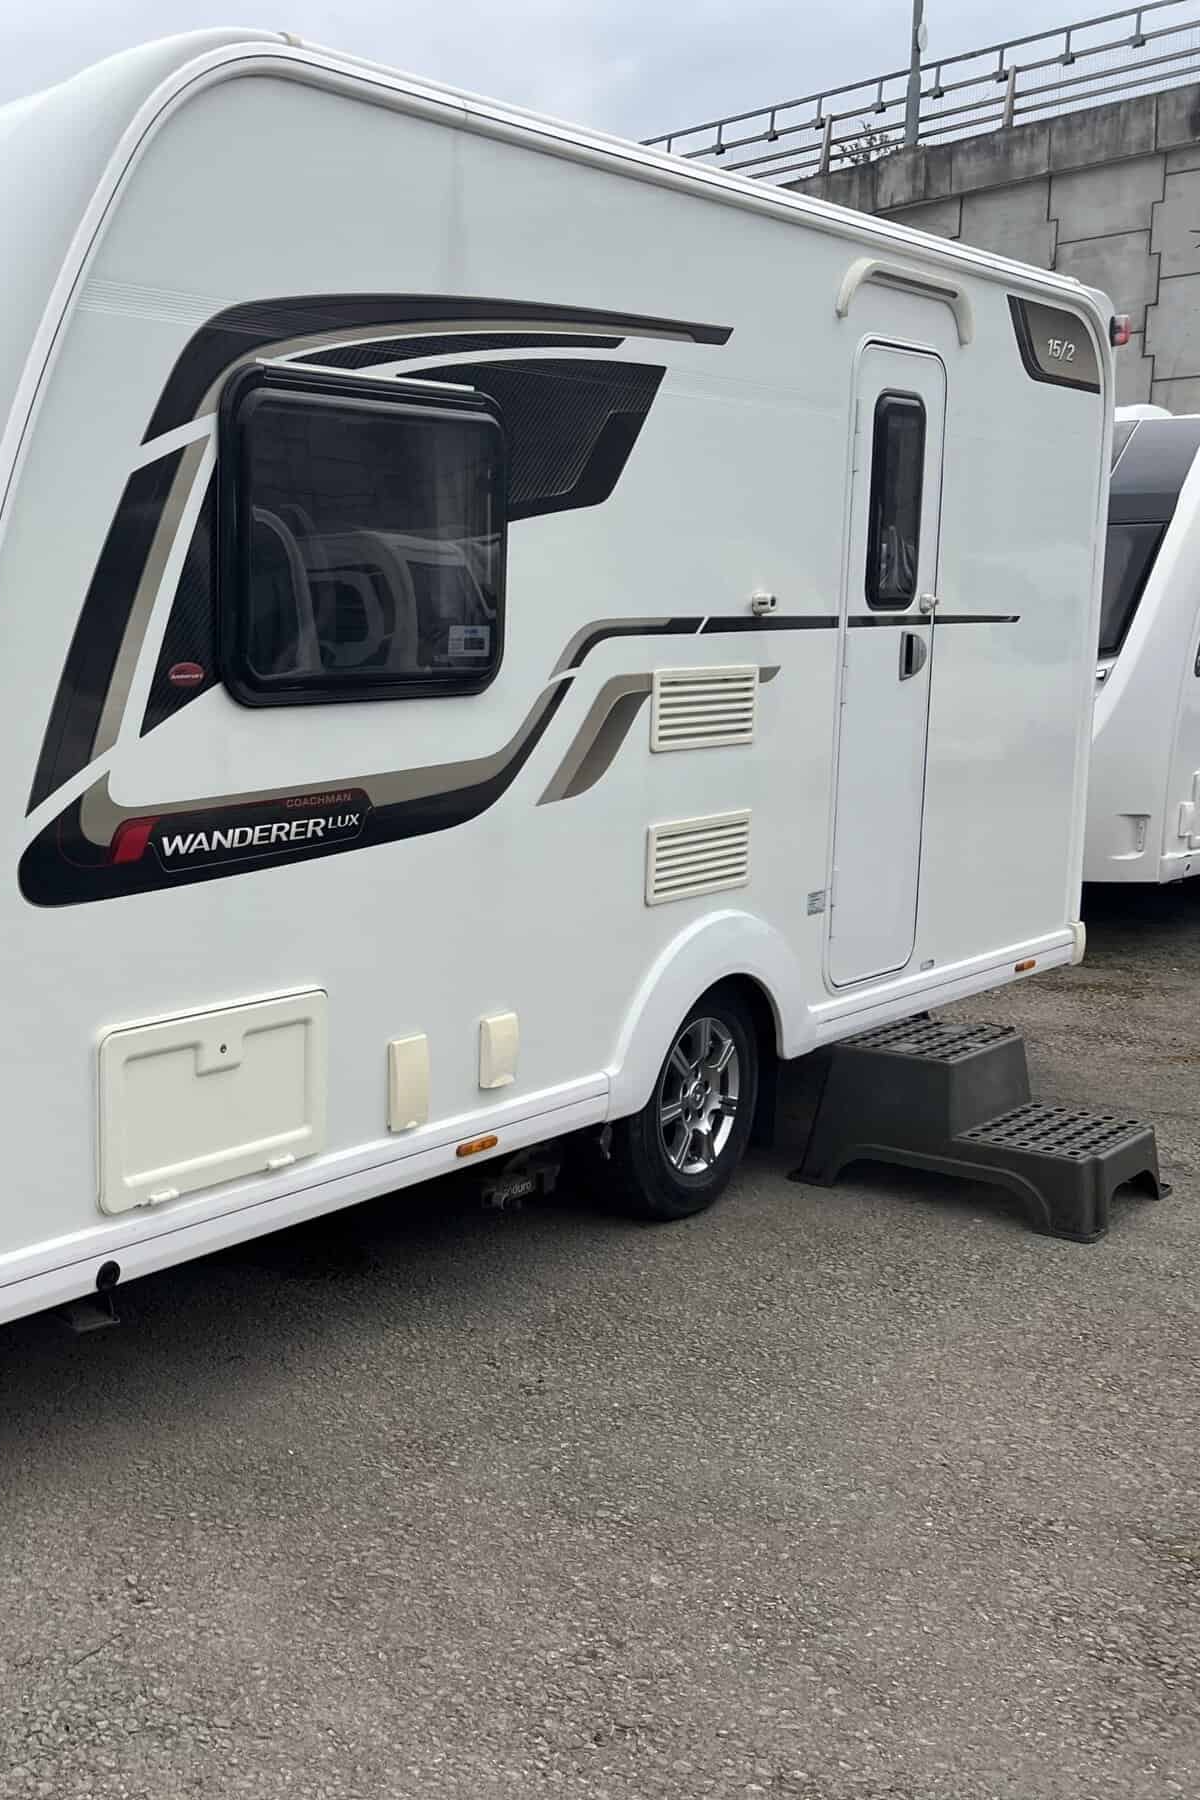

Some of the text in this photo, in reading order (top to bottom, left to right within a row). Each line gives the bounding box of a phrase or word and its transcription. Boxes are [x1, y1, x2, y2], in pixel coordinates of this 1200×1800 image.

[1047, 339, 1076, 362] 15/2
[287, 792, 352, 809] COACHMAN
[162, 813, 360, 857] WANDERER LUX
